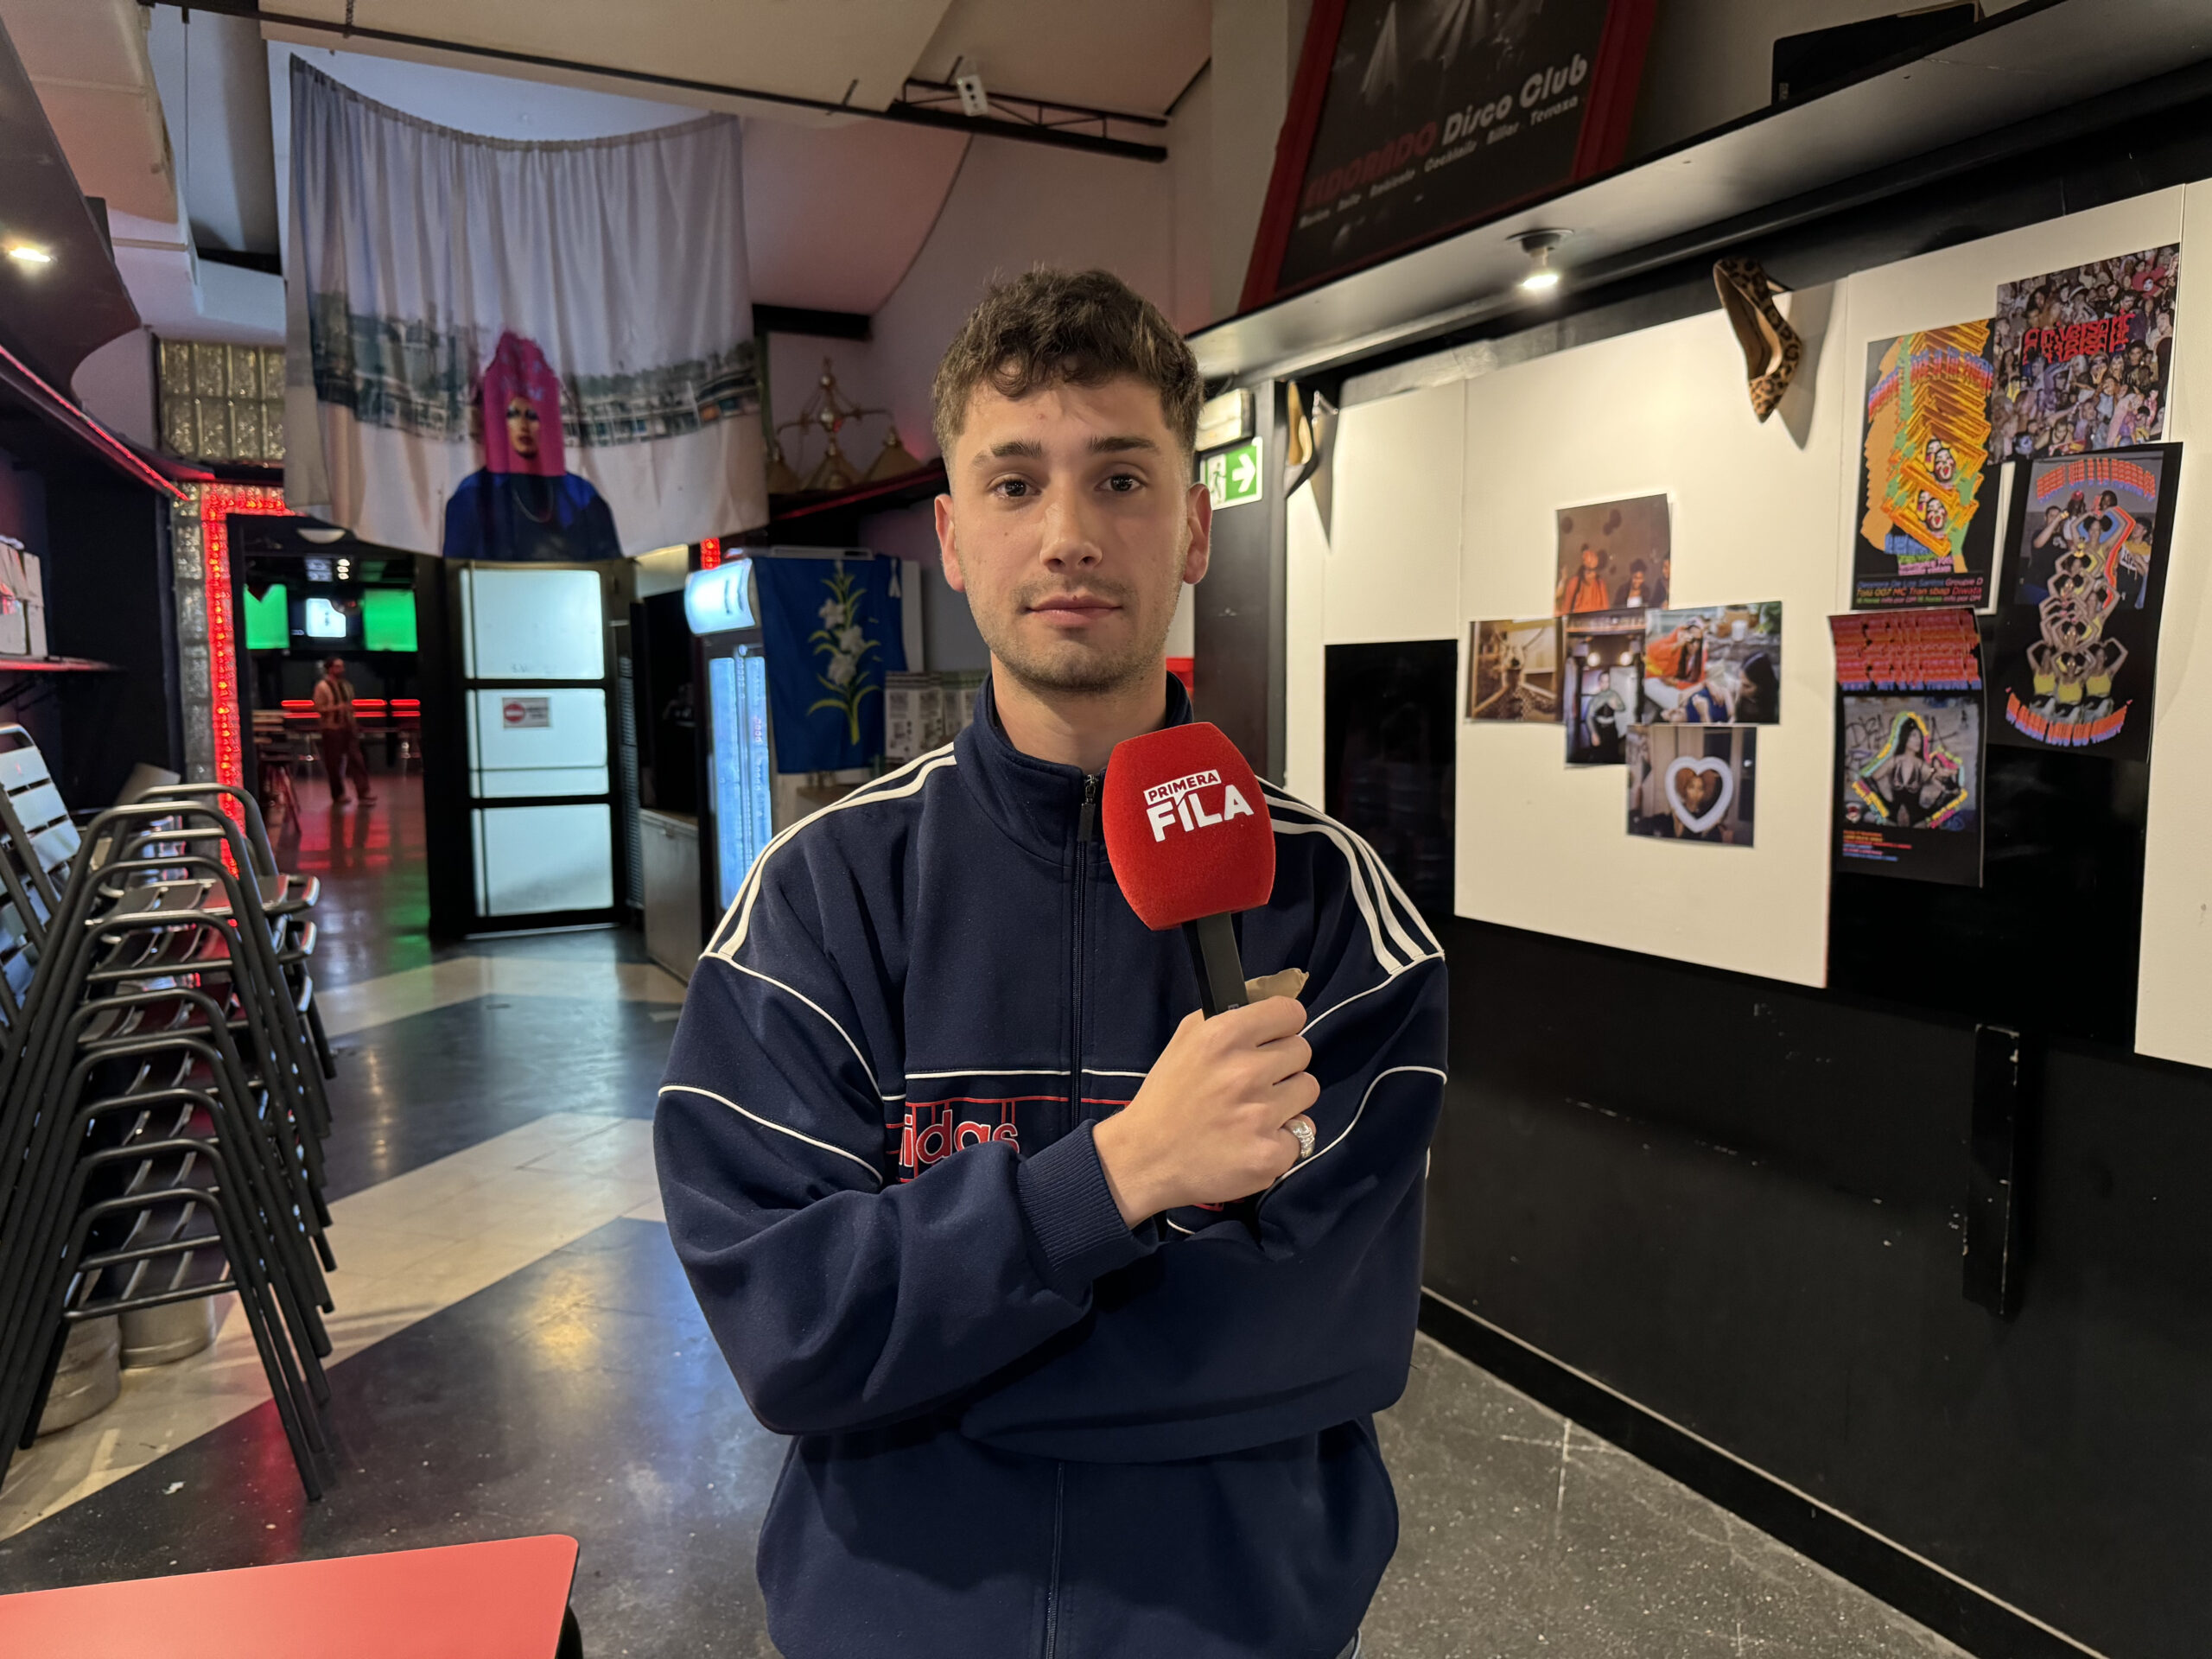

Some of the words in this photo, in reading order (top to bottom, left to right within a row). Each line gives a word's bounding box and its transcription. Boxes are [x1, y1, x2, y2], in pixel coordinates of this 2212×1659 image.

[1441, 94, 1513, 146] Disco
[1519, 53, 1588, 108] Club
[1147, 784, 1254, 842] FILA
[1148, 772, 1218, 802] PRIMERA
[899, 1109, 1020, 1166] idas
